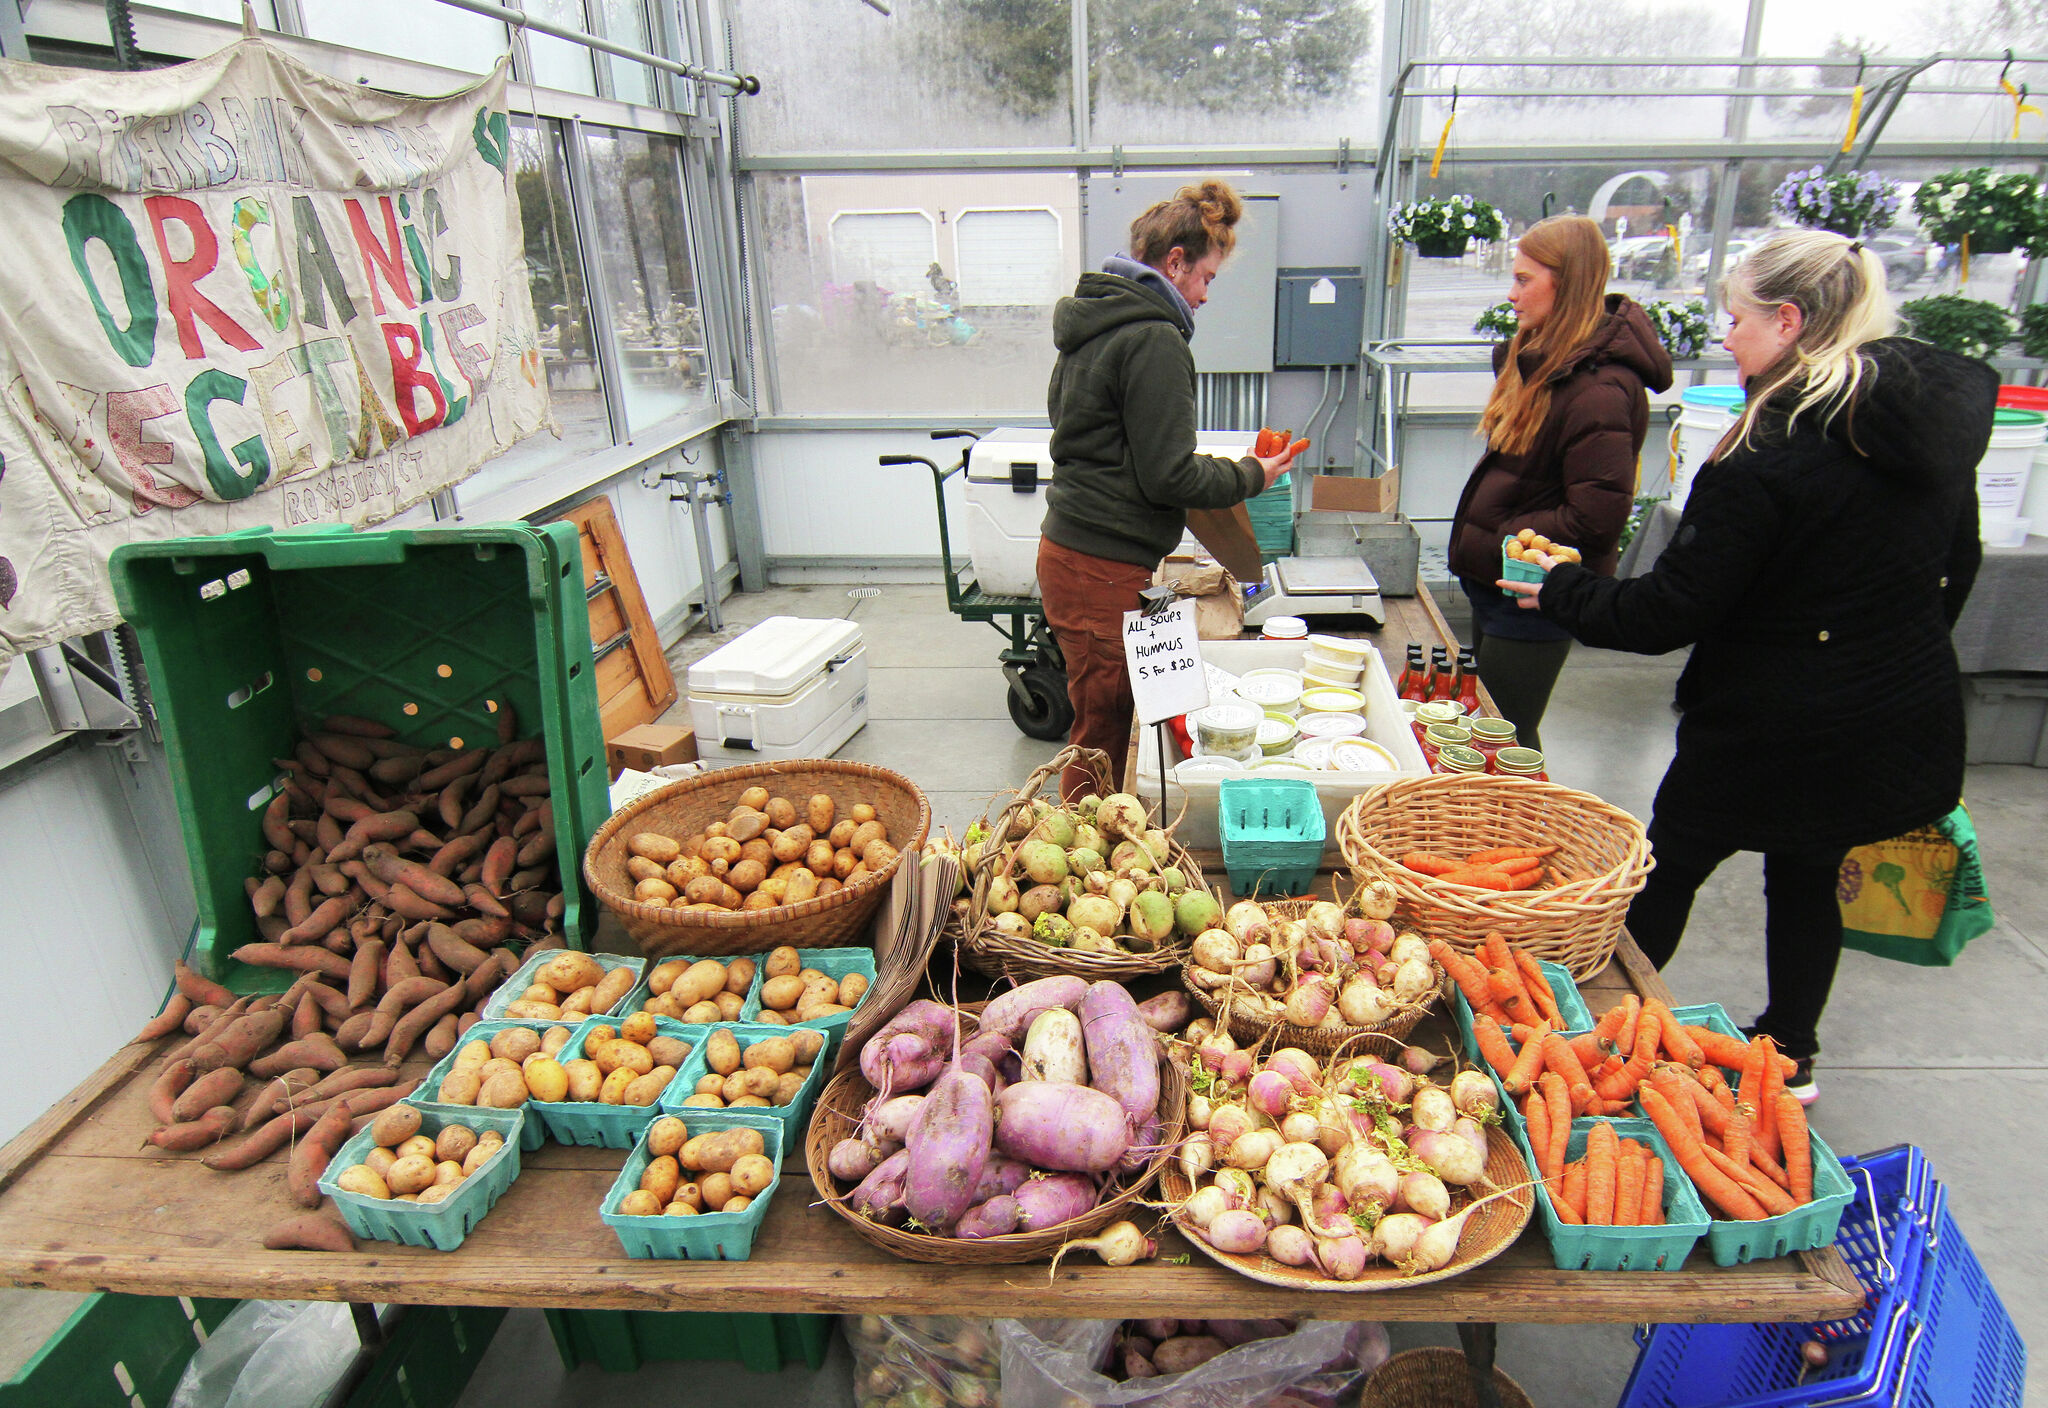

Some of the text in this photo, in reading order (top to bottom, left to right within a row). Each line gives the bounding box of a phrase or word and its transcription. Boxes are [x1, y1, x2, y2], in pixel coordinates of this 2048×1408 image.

[333, 123, 449, 190] FARM
[398, 451, 423, 483] CT
[1127, 610, 1182, 635] ALL SOUPS
[1149, 630, 1156, 640] +
[1135, 637, 1183, 660] HUMMUS
[1138, 666, 1149, 680] 5
